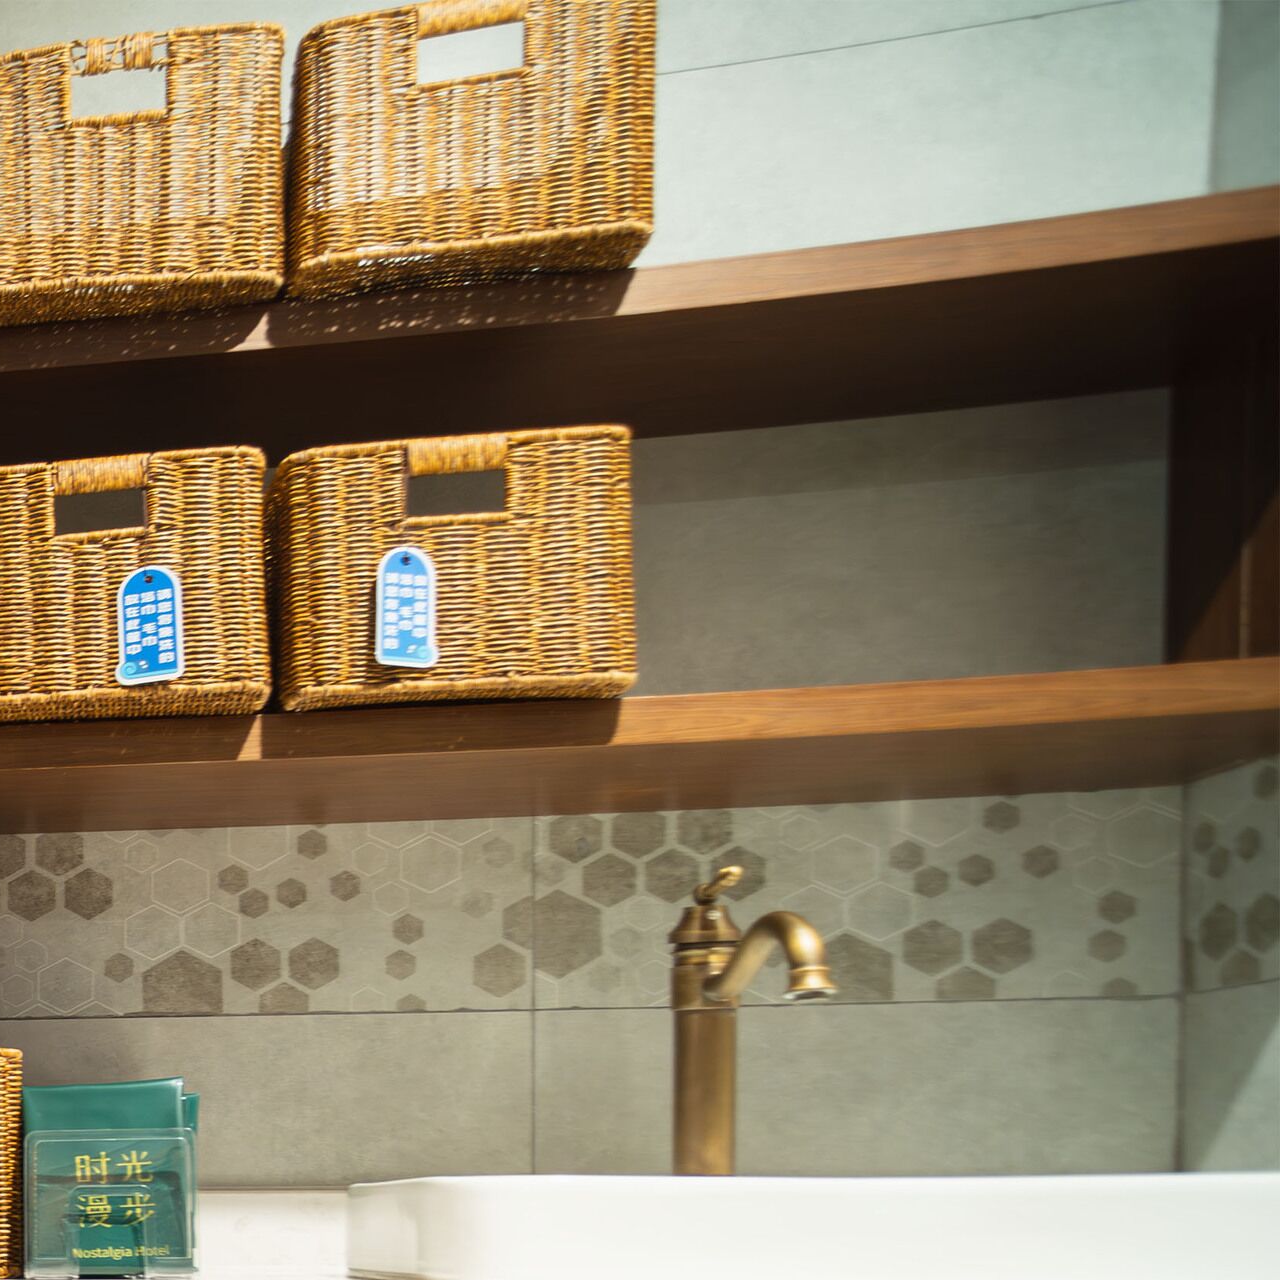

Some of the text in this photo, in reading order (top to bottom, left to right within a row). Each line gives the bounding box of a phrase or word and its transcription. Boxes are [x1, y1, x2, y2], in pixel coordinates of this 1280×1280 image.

[75, 1150, 153, 1184] 时光
[75, 1192, 156, 1227] 漫步
[72, 1245, 170, 1260] Nostalgia Hotel
